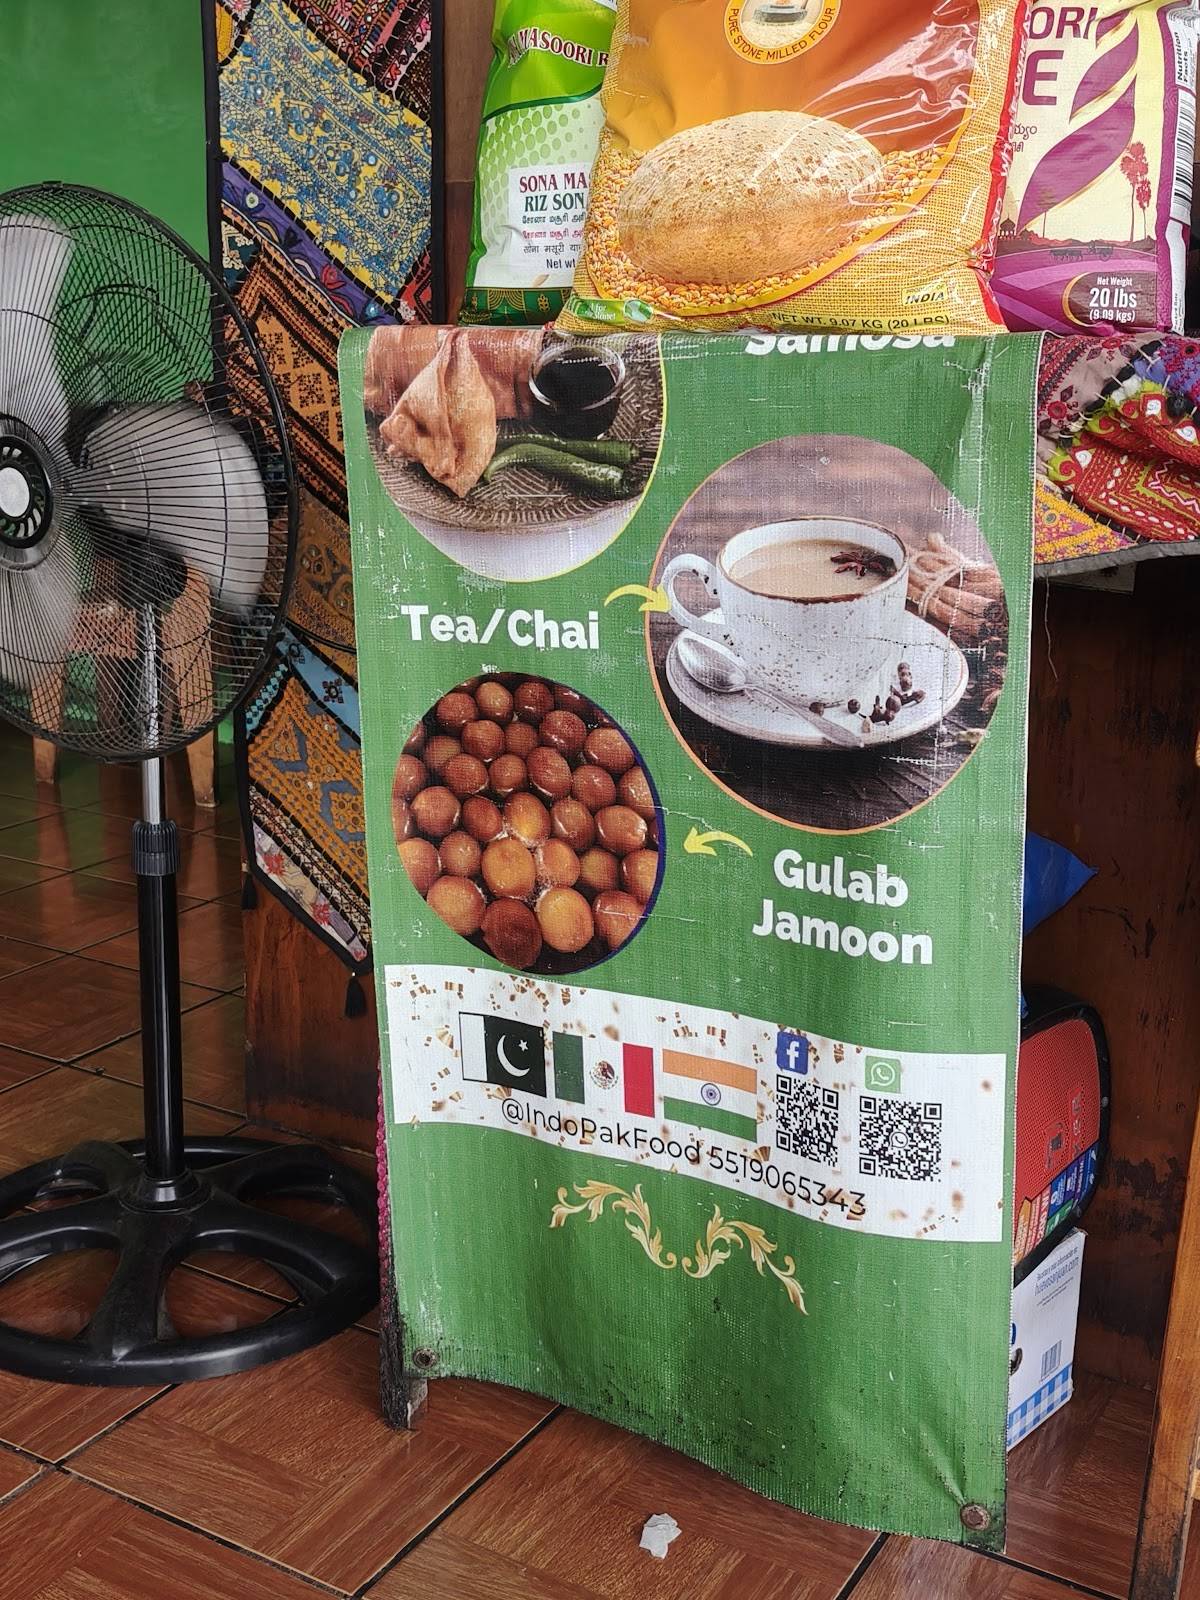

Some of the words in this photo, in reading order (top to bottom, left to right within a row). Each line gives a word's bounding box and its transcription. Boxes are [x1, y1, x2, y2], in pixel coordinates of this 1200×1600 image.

[728, 8, 740, 36] PURE
[808, 7, 836, 41] FLOUR
[1028, 6, 1098, 41] ORI
[733, 35, 764, 60] STONE
[766, 40, 808, 60] MILLED
[1173, 31, 1183, 81] Nutrition
[519, 174, 558, 194] SONA
[563, 171, 588, 190] MA
[524, 194, 548, 213] RIZ
[552, 192, 585, 211] SON
[546, 258, 562, 270] Net
[1096, 276, 1109, 286] Net
[1110, 276, 1133, 287] Weight
[904, 291, 945, 306] INDIA
[1089, 287, 1111, 308] 20
[1113, 287, 1138, 308] lbs
[770, 312, 798, 323] NET
[800, 316, 827, 326] WT.
[829, 317, 857, 327] 9.07
[861, 319, 883, 329] KG
[887, 318, 908, 331] (20
[1115, 309, 1136, 324] kgs)
[400, 604, 600, 650] Tea/Chai
[773, 848, 909, 908] Gulab
[752, 898, 933, 965] Jamoon
[501, 1097, 702, 1165] @IndoPakFood
[708, 1145, 868, 1217] 5519065343
